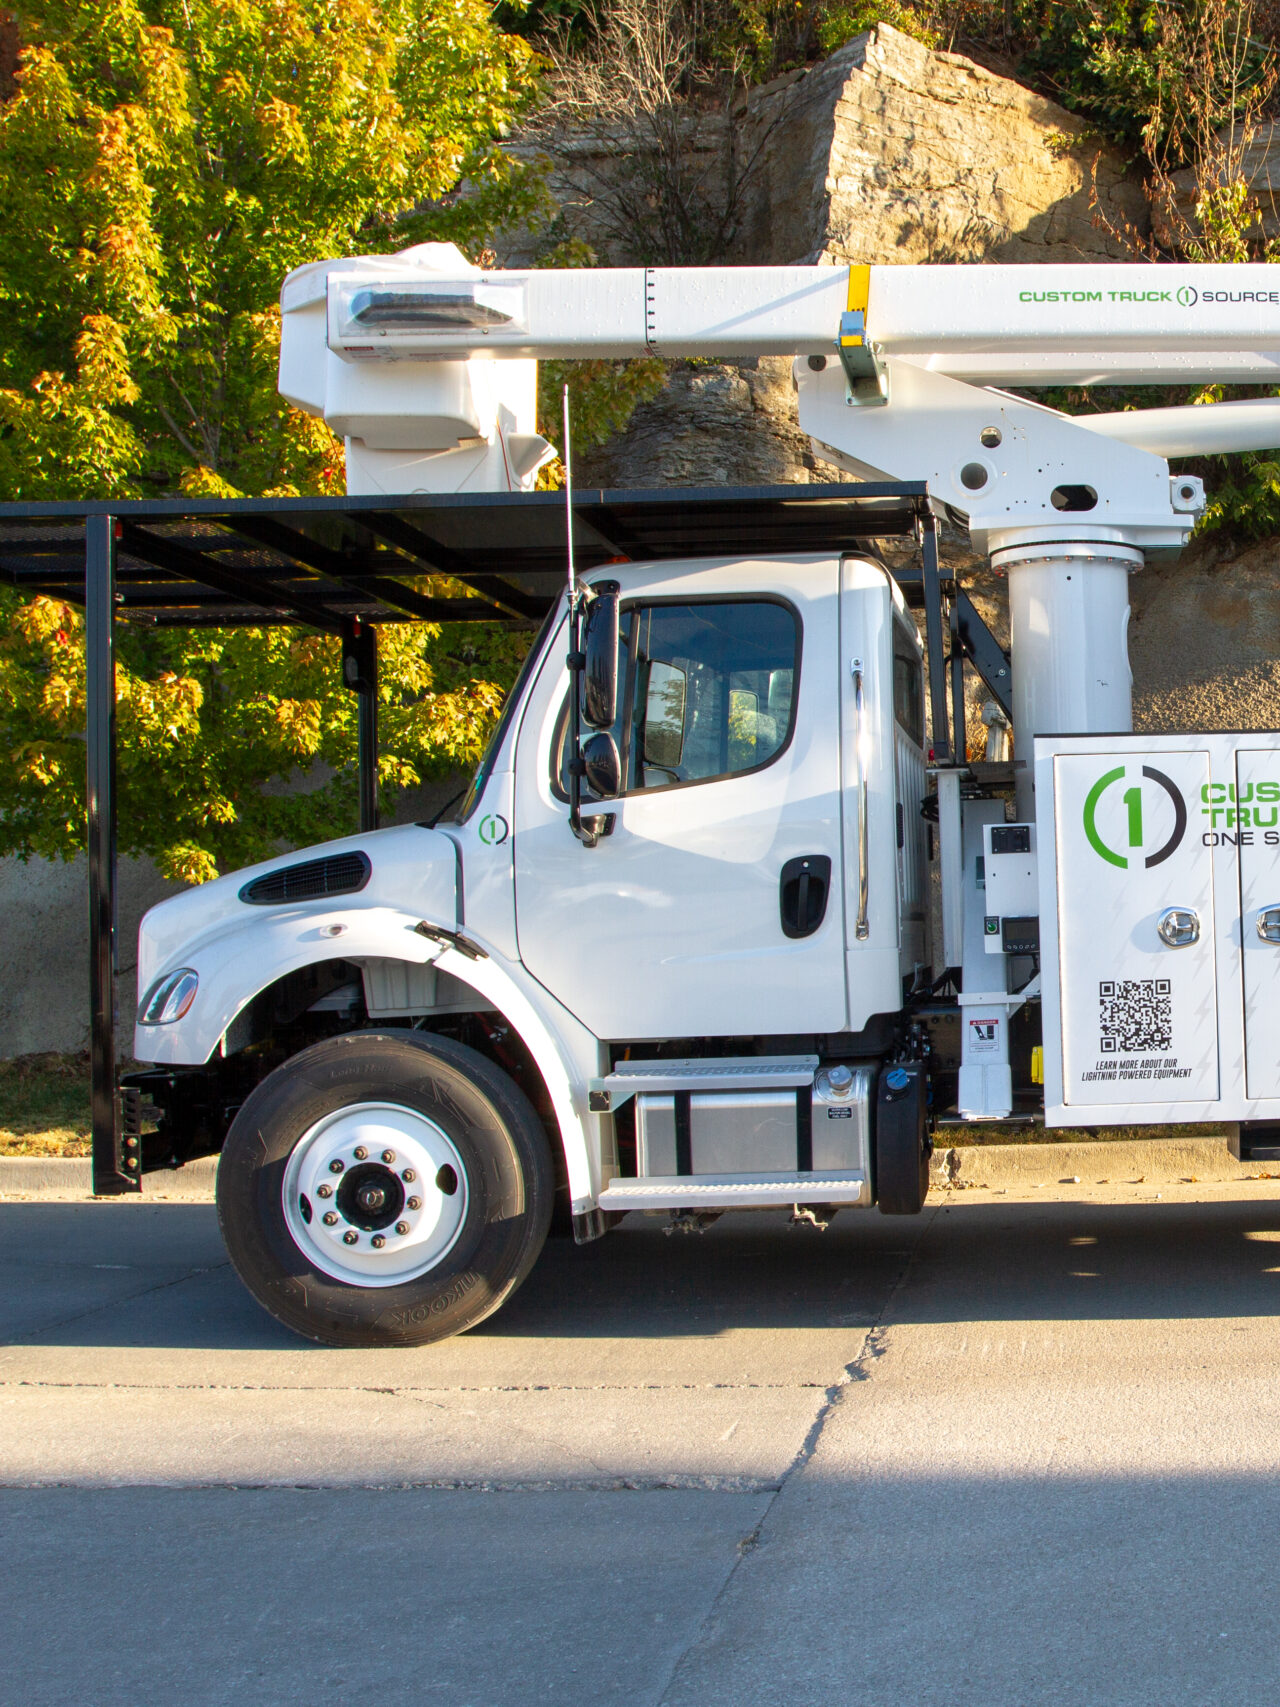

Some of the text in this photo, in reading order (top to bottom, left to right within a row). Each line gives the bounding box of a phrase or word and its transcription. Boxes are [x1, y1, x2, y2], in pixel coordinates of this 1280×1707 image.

[1019, 291, 1101, 302] CUSTOM
[1108, 291, 1172, 302] TRUCK
[1202, 291, 1279, 302] SOURCE
[1202, 831, 1254, 847] ONE
[1096, 1058, 1178, 1071] LEARN MORE ABOUT OUR
[1081, 1068, 1193, 1082] LIGHTNING POWERED EQUIPMENT
